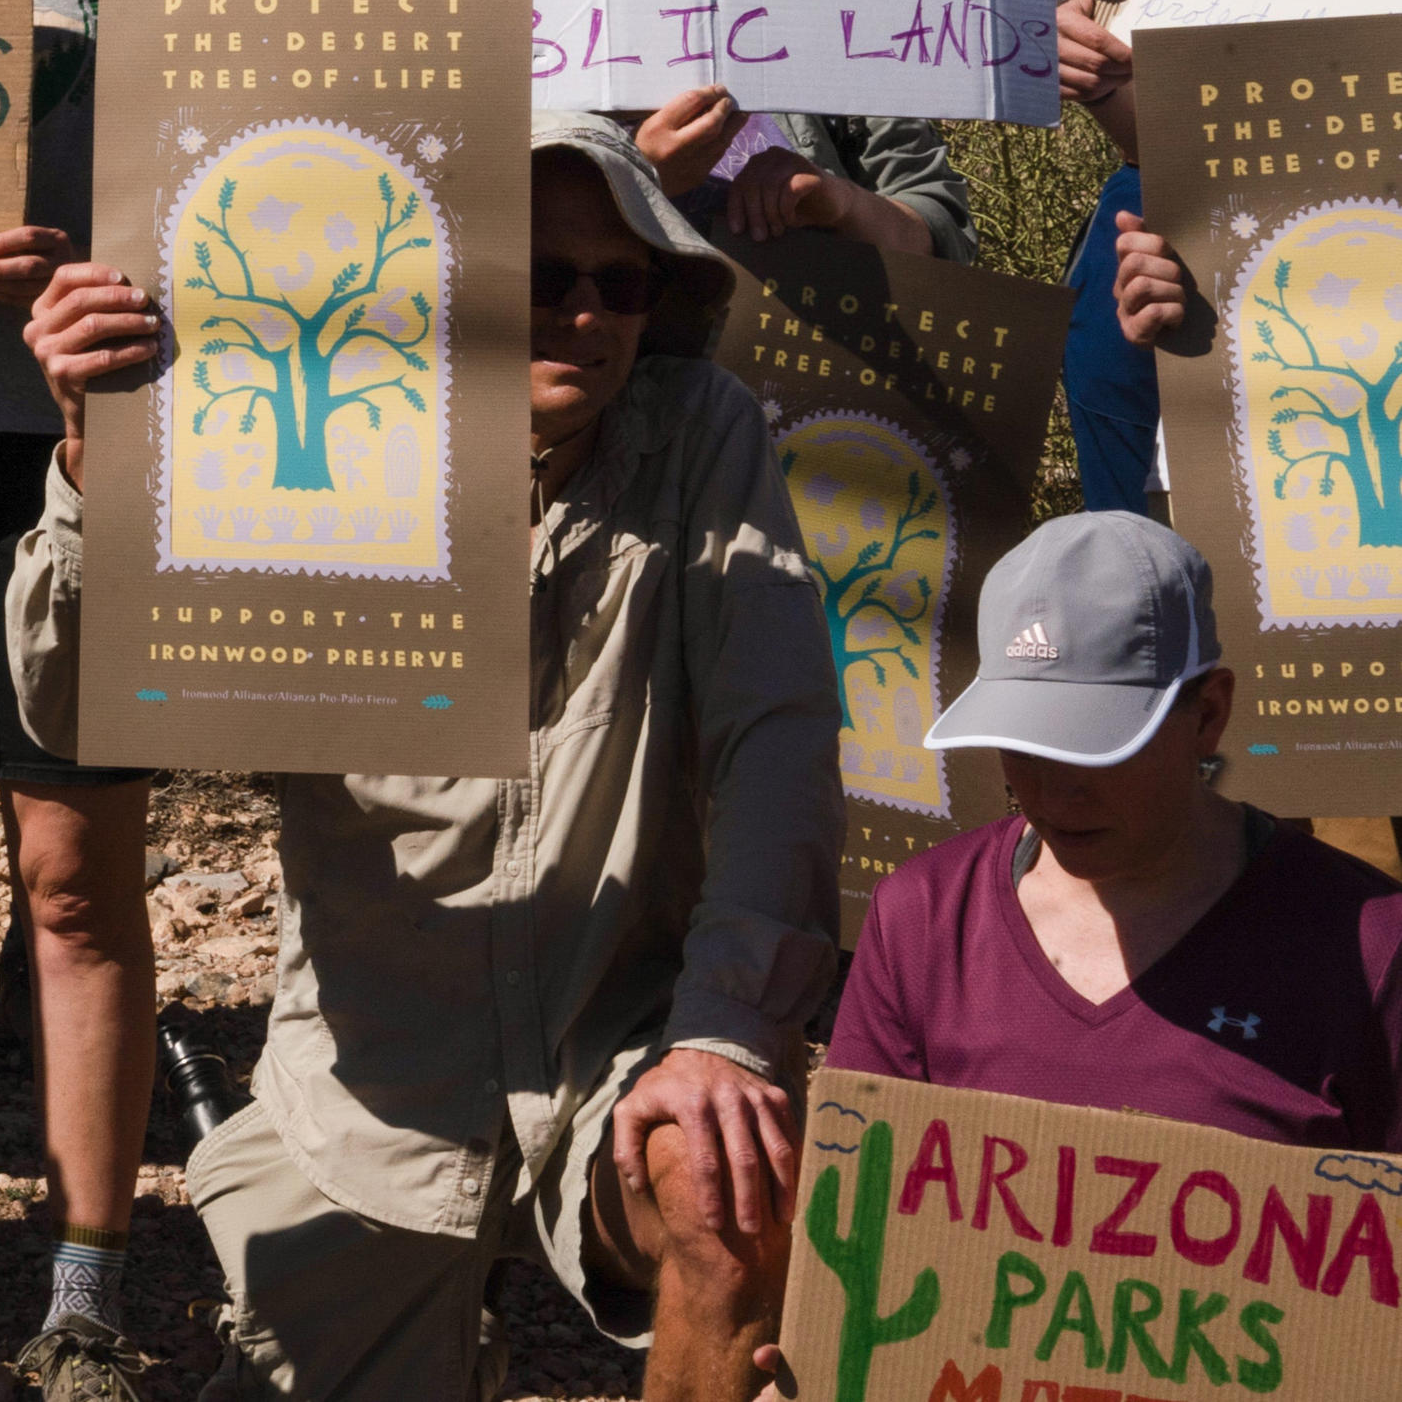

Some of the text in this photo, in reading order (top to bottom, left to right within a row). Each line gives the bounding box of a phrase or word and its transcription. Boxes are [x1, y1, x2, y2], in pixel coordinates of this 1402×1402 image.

[163, 31, 463, 52] THE DESERT
[532, 6, 790, 78] BLIC
[163, 68, 463, 89] TREE OF LIFE
[1202, 118, 1283, 143] THE
[1205, 148, 1381, 178] TREE OF
[759, 313, 824, 342] THE
[762, 278, 1009, 348] PROTECT
[754, 345, 996, 412] TREE OF LIFE
[151, 606, 464, 630] SUPPORT THE
[149, 643, 464, 669] IRONWOOD PRESERVE
[1005, 641, 1059, 661] adidas
[897, 1118, 1402, 1308] ARIZONA
[985, 1250, 1286, 1394] PARKS
